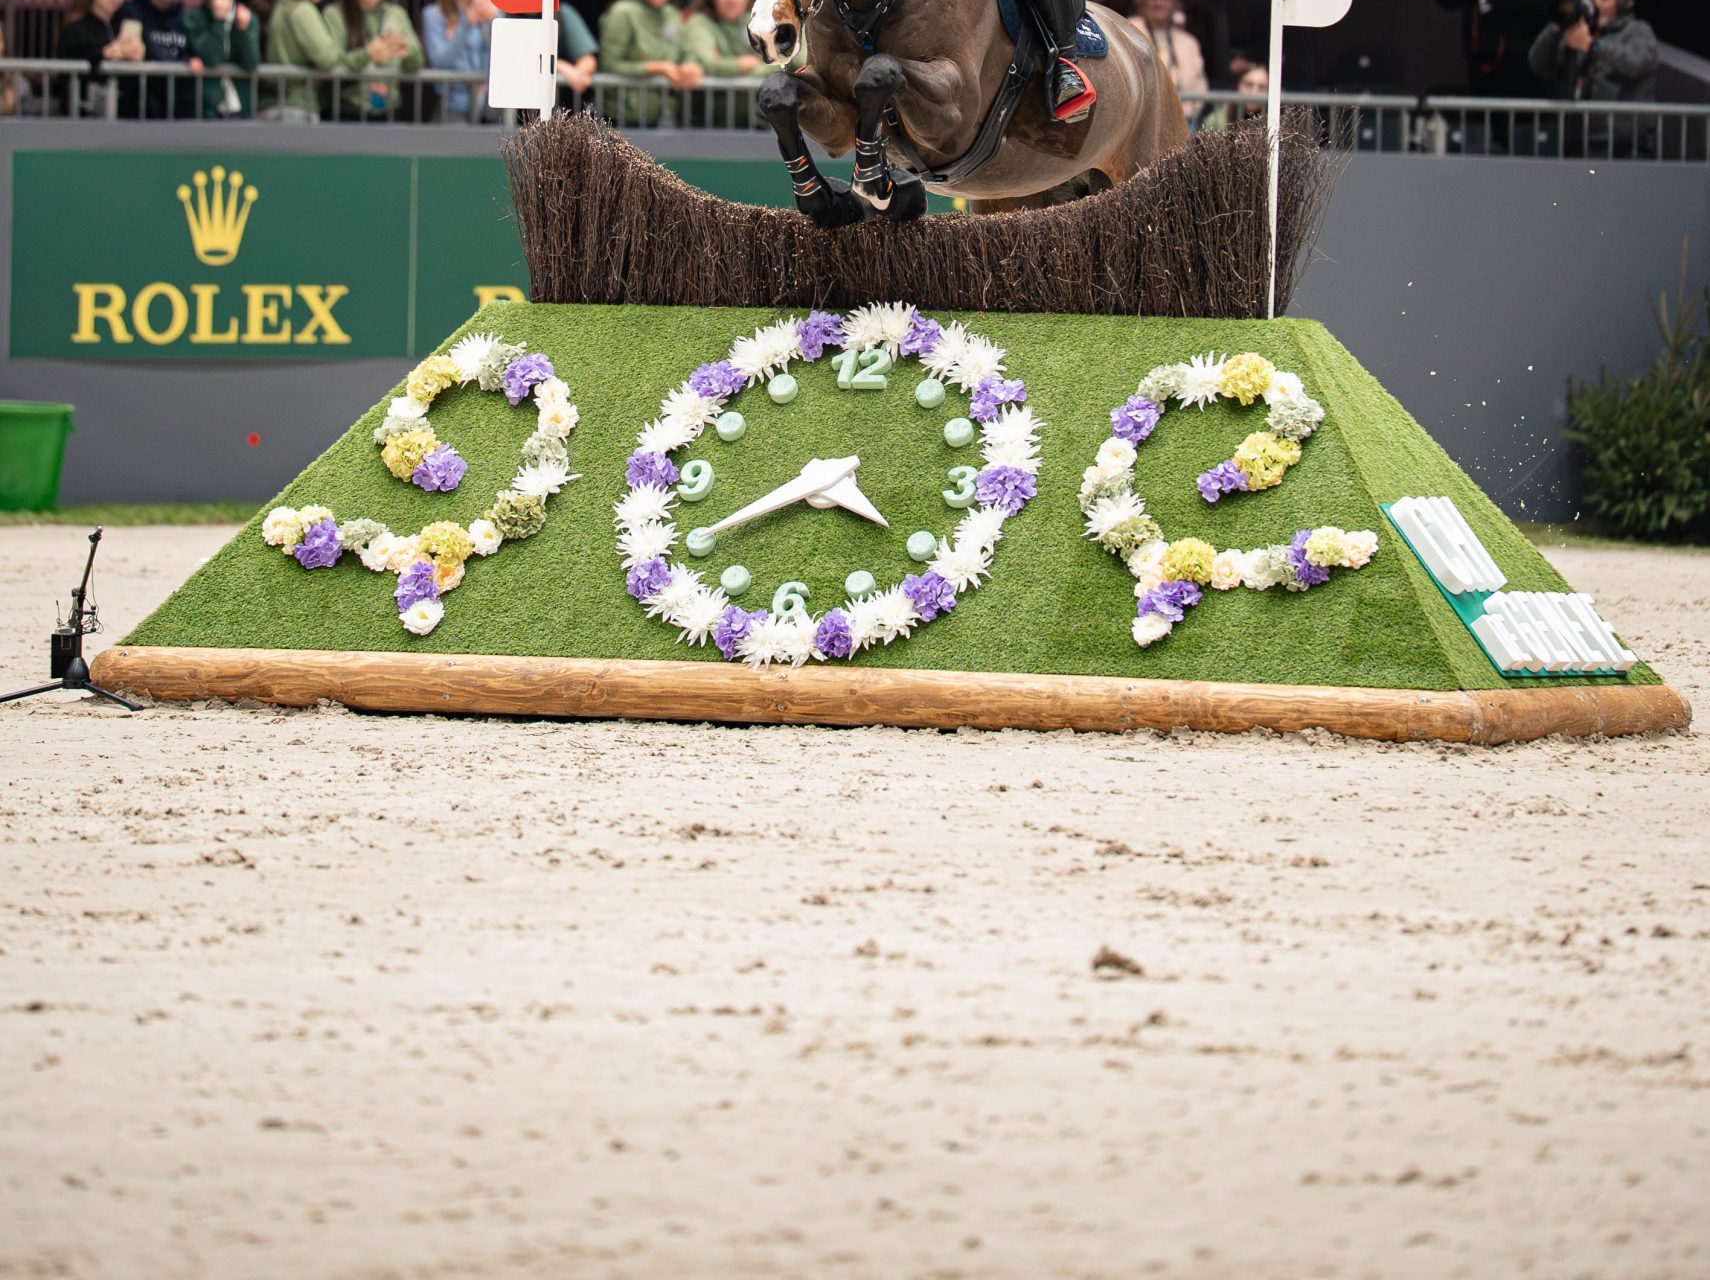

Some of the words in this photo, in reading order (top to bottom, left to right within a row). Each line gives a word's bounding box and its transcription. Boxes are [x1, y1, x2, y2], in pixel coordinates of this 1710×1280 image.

[71, 282, 351, 346] ROLEX
[831, 348, 893, 390] 12
[676, 459, 715, 502] 9
[942, 465, 978, 509] 3
[1389, 496, 1508, 595] CHI
[771, 581, 810, 621] 6
